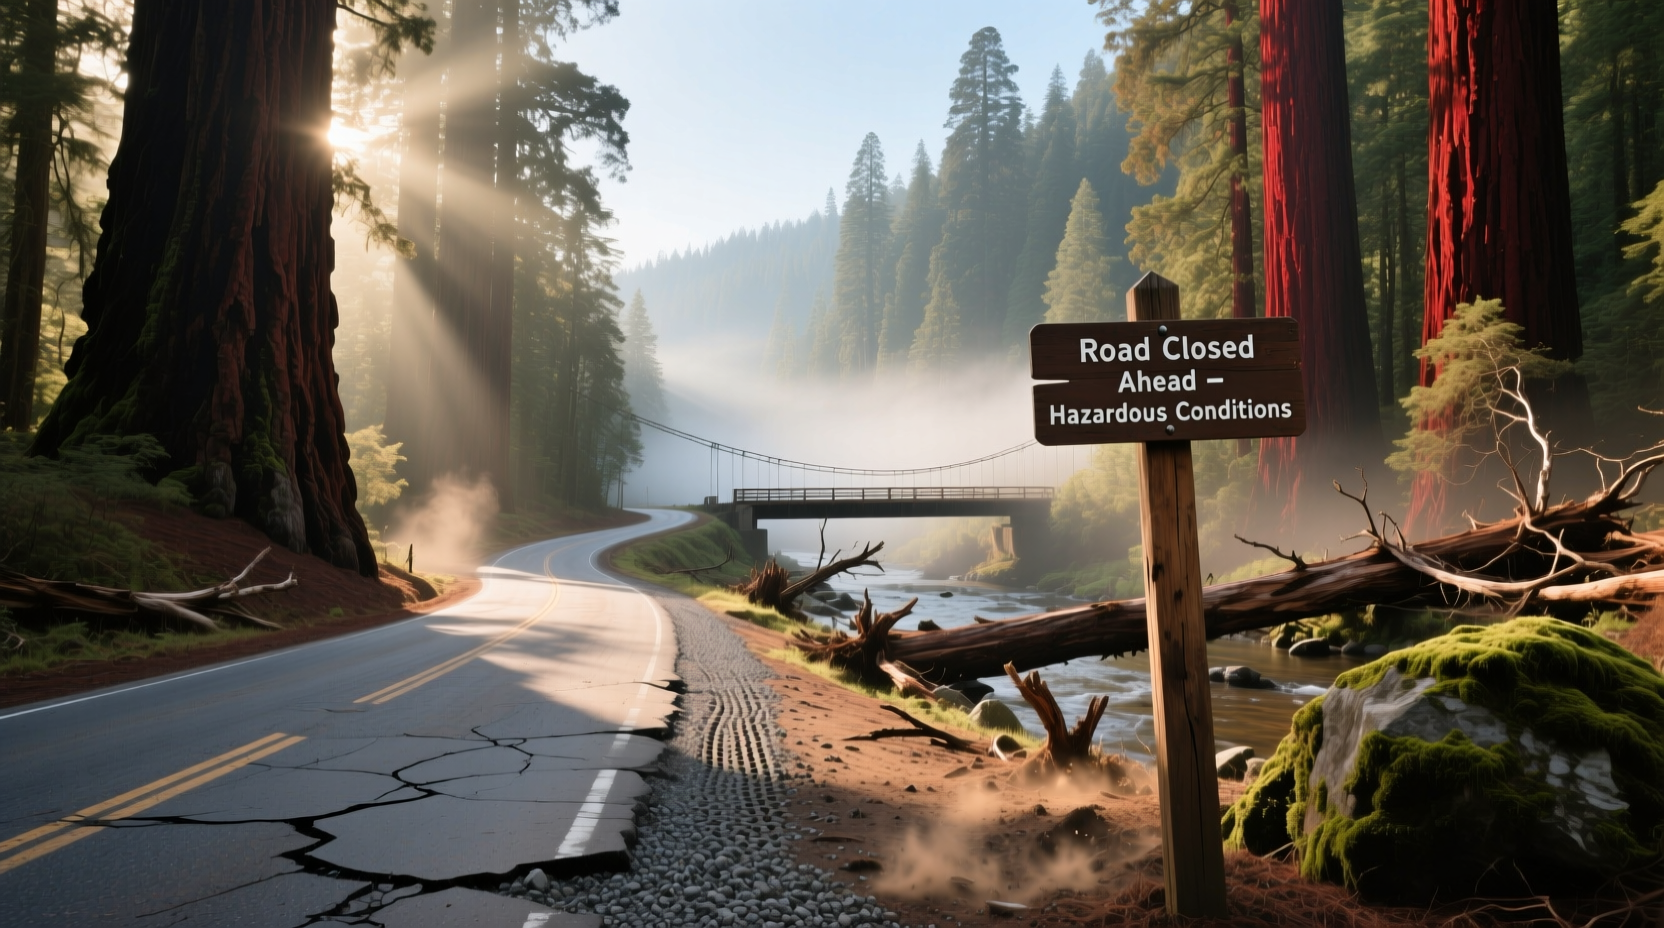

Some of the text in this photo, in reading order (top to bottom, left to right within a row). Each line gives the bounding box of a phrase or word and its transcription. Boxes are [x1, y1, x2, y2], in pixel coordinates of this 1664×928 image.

[1079, 334, 1255, 363] Road Closed
[1118, 369, 1197, 393] Ahead
[1049, 399, 1293, 425] Hazardous Conditions
